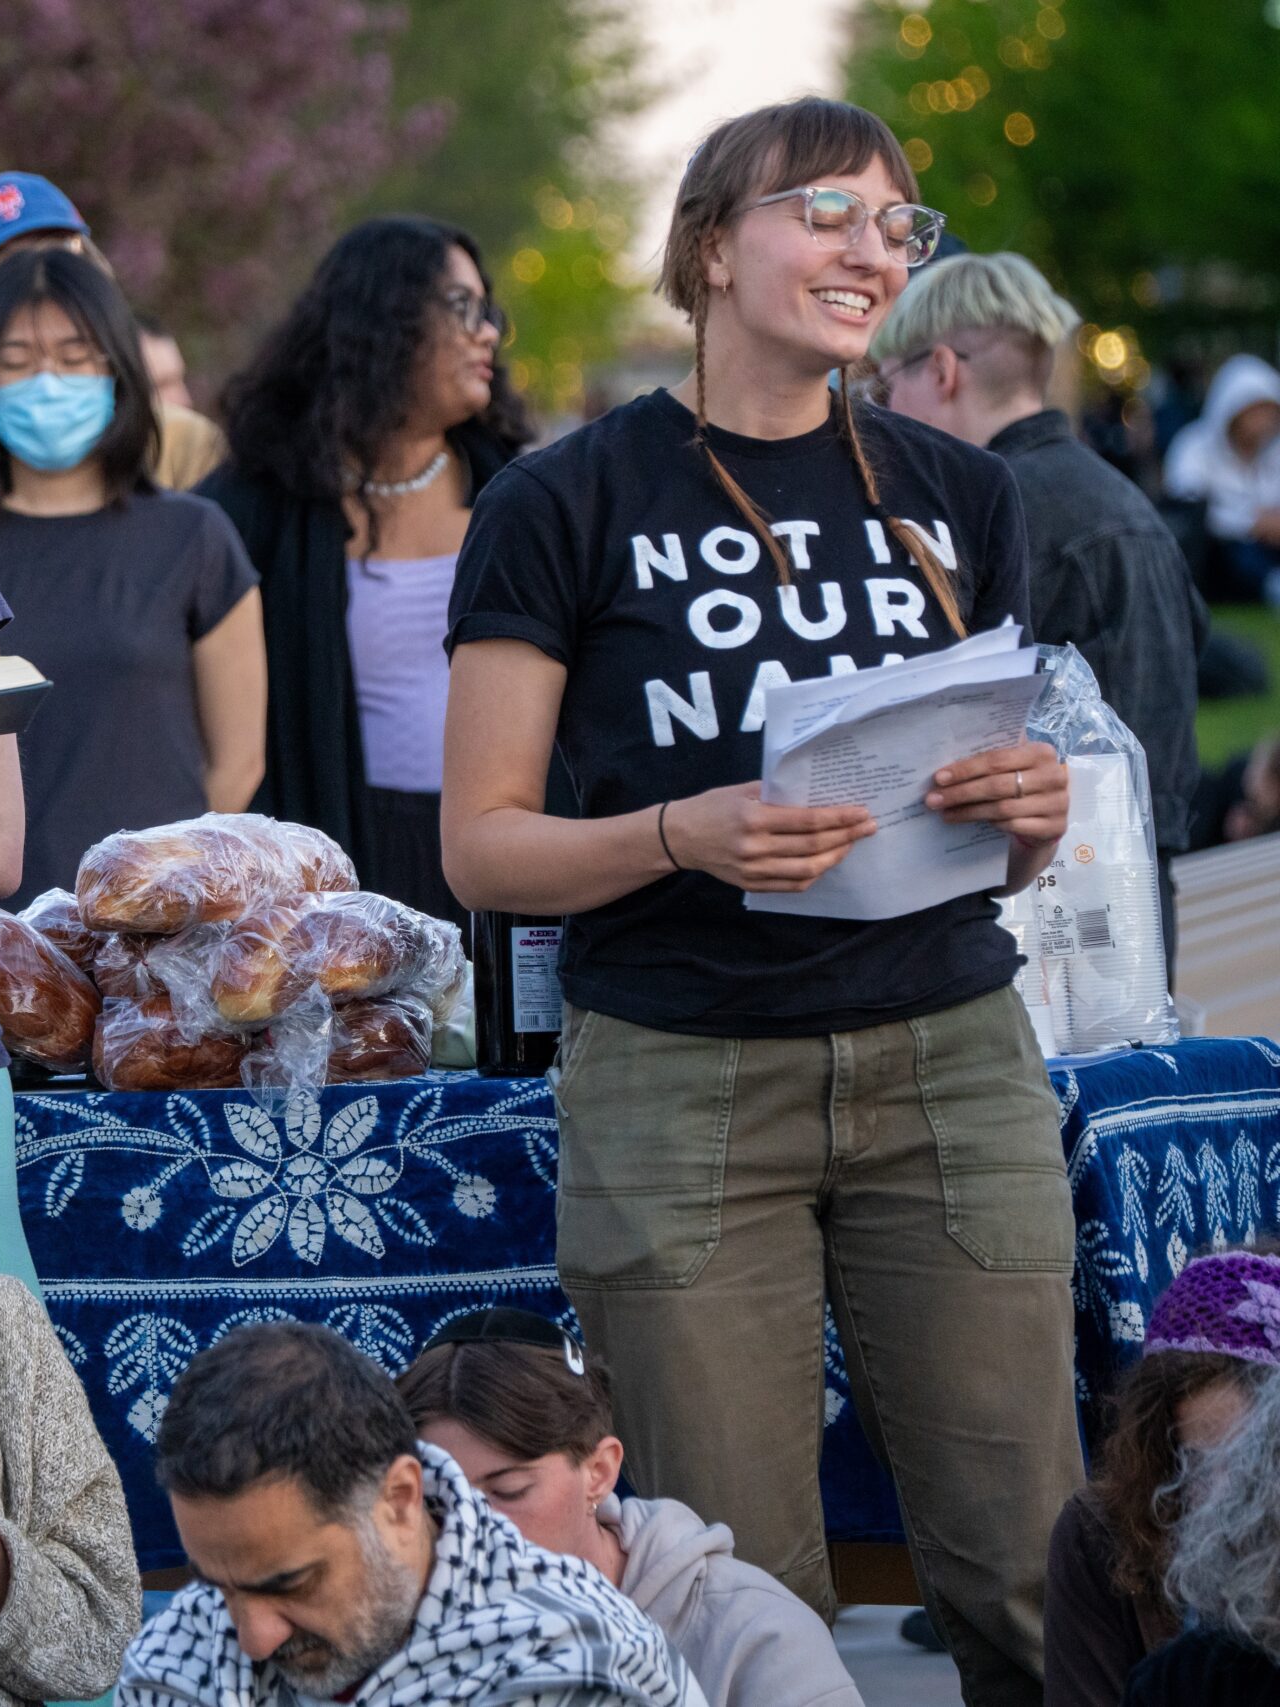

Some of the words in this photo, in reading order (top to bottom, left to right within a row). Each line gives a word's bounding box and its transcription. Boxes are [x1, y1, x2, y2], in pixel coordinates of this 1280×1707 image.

[632, 520, 820, 589] NOT
[864, 519, 957, 570] IN
[688, 577, 929, 649] OUR
[644, 654, 905, 747] NA
